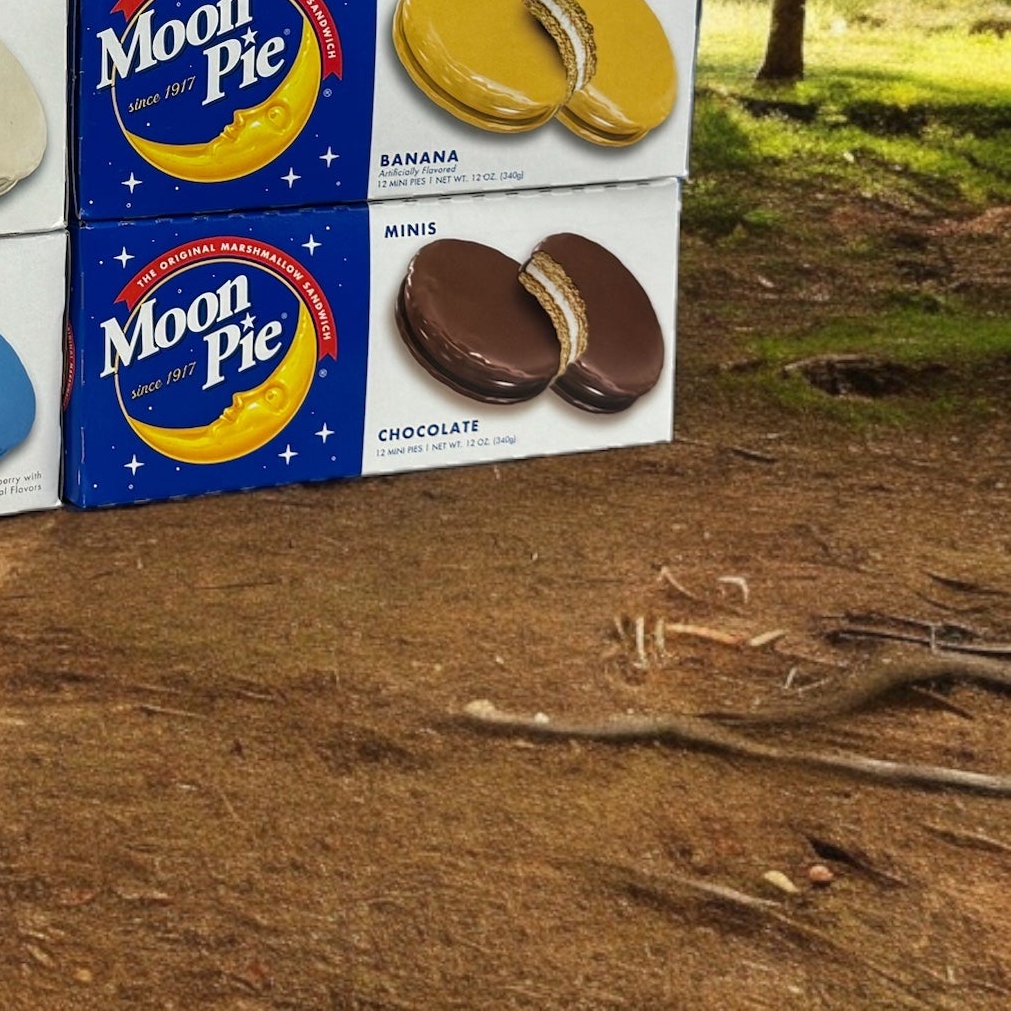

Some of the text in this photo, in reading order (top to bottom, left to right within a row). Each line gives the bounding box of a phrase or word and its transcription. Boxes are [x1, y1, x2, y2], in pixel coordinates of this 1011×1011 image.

[202, 27, 285, 106] Pie
[128, 76, 196, 112] since 1917
[378, 164, 457, 178] Artificially Flavored
[380, 149, 459, 167] BANANA
[384, 222, 437, 238] MINIS
[137, 242, 331, 341] THE ORIGINAL MARSHMALLOW SANDWICH
[100, 274, 251, 378] Moon
[202, 312, 282, 390] Pie
[131, 361, 197, 399] since 1917
[378, 420, 479, 441] CHOCOLATE
[10, 484, 42, 494] Flavors
[24, 471, 42, 481] with
